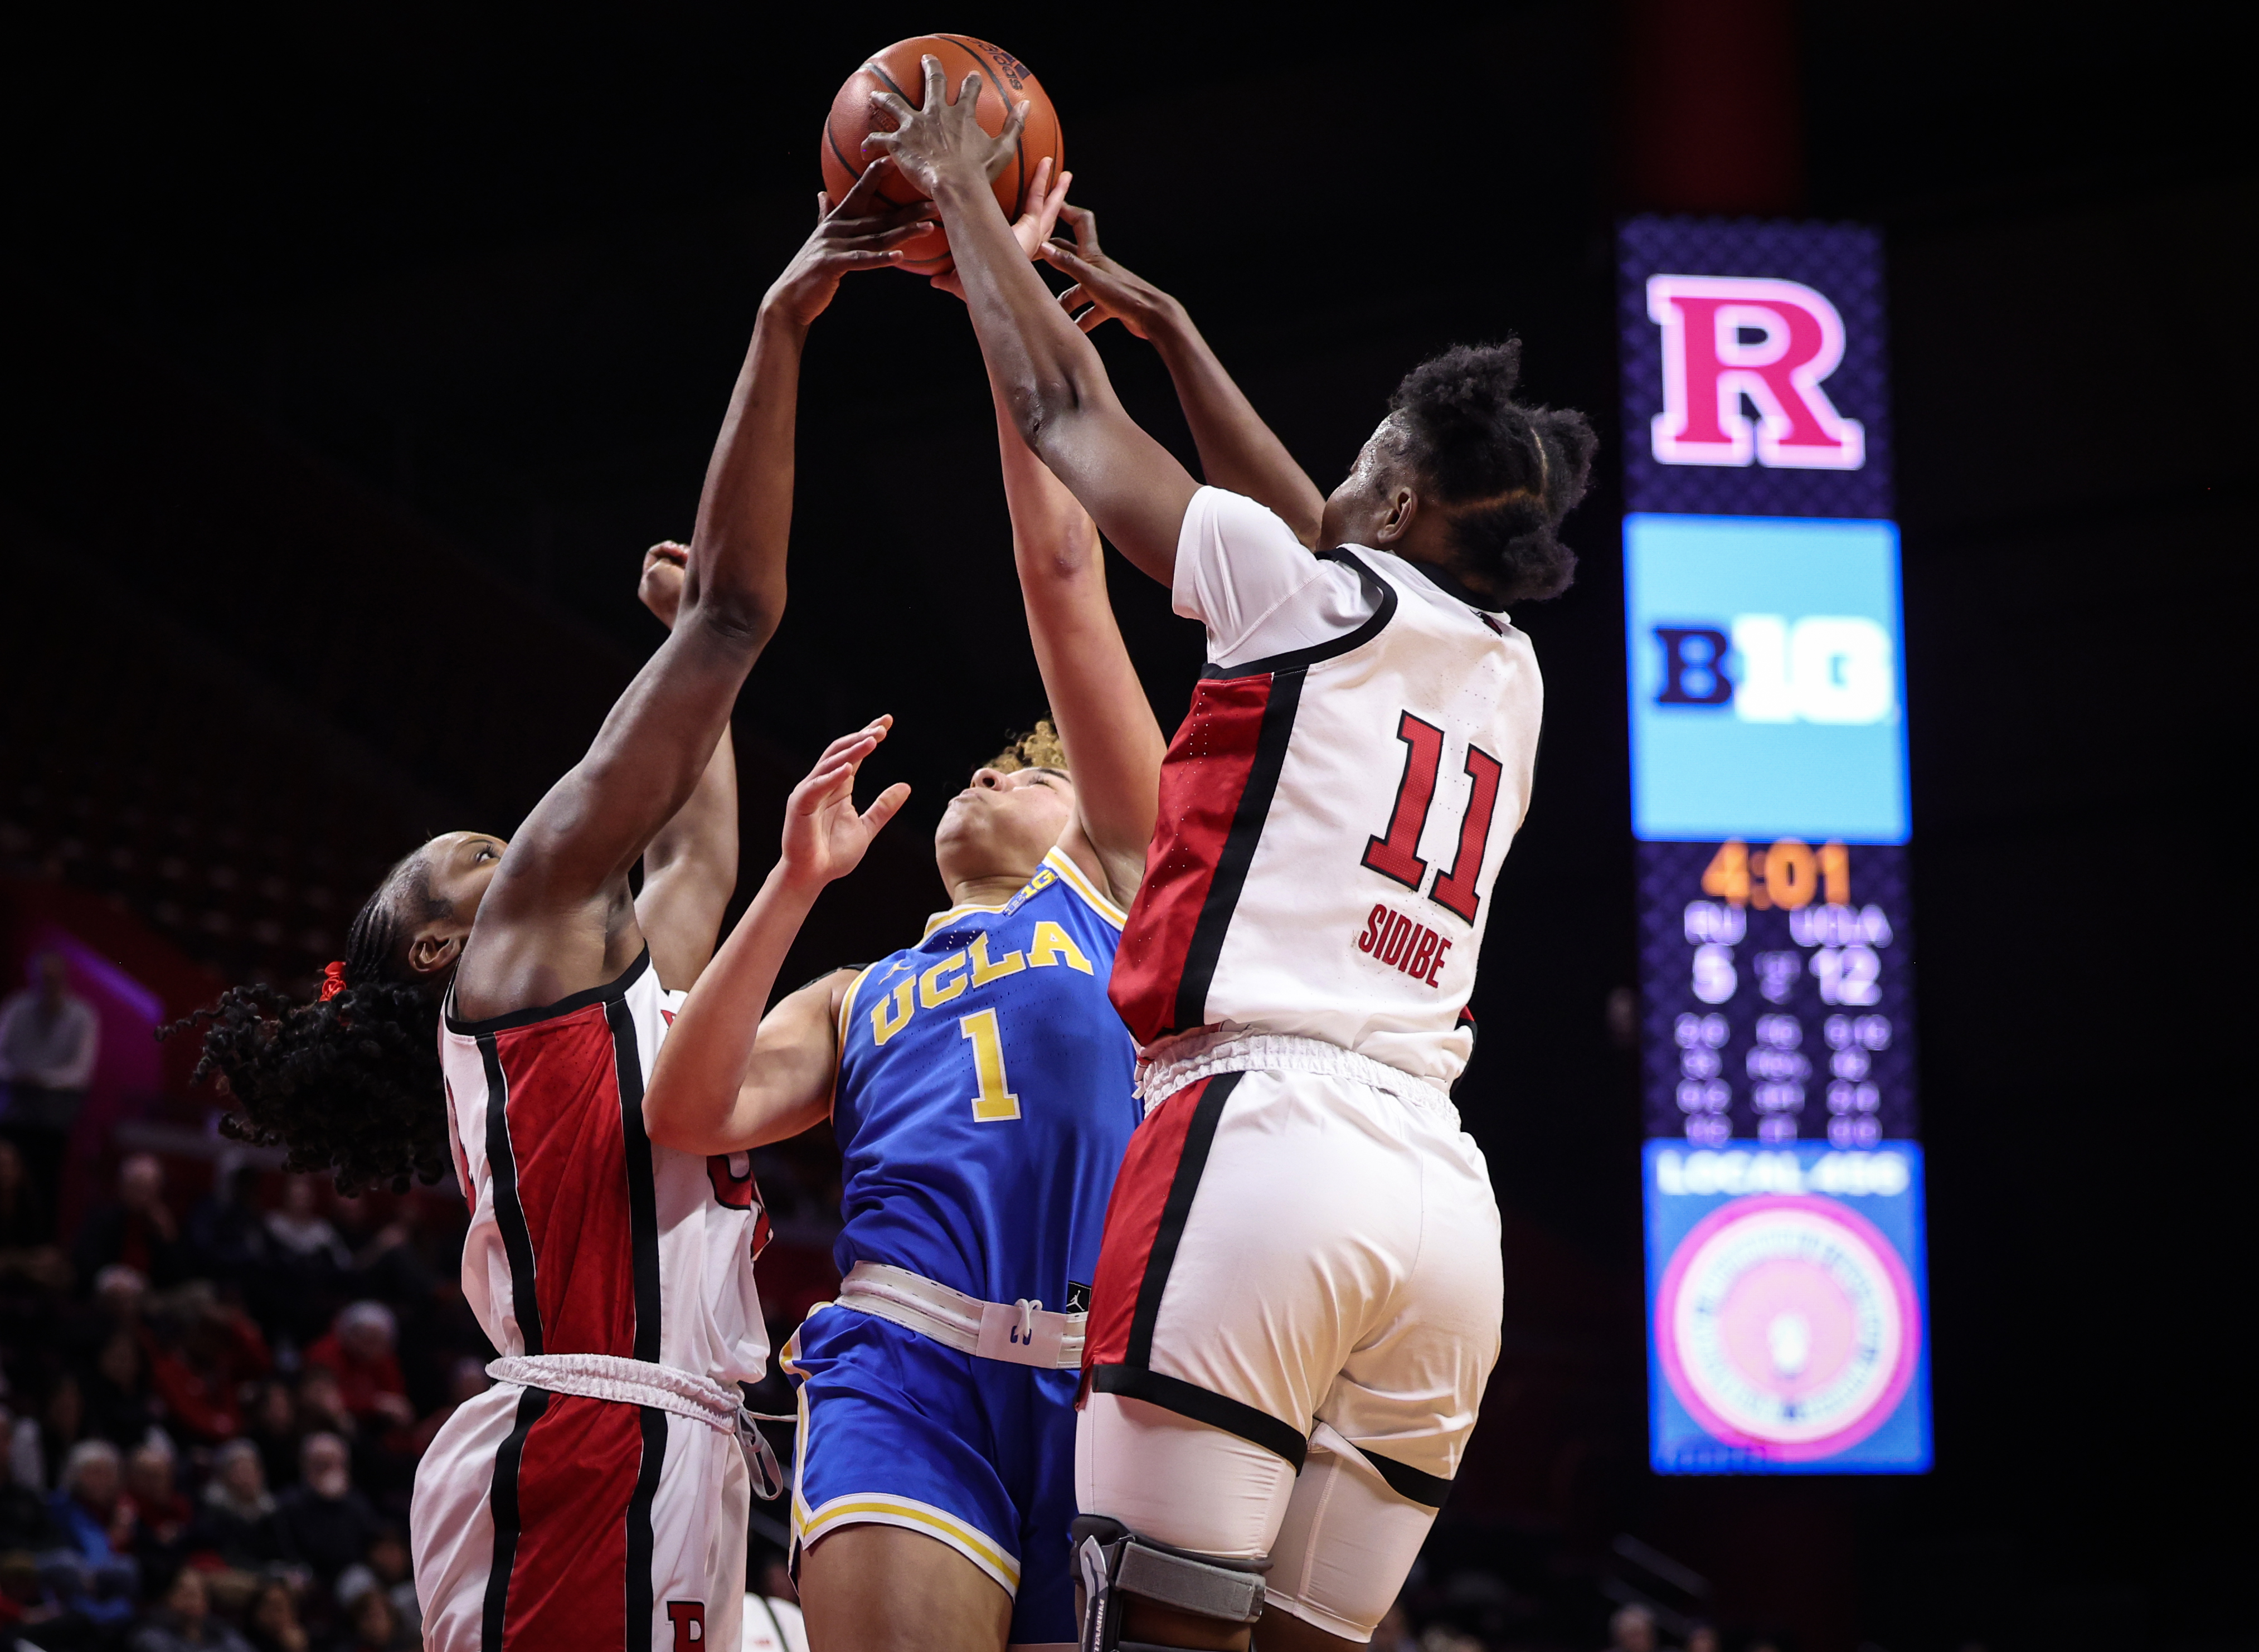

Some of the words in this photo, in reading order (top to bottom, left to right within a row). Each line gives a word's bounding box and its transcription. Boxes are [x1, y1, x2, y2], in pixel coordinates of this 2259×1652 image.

[1647, 274, 1866, 470] R
[1360, 709, 1503, 929] 11
[1701, 838, 1850, 910] 4:01
[871, 921, 1094, 1046] UCLA
[1358, 903, 1452, 989] SIDIBE
[1809, 945, 1882, 1005] 12
[959, 1008, 1021, 1123] 1
